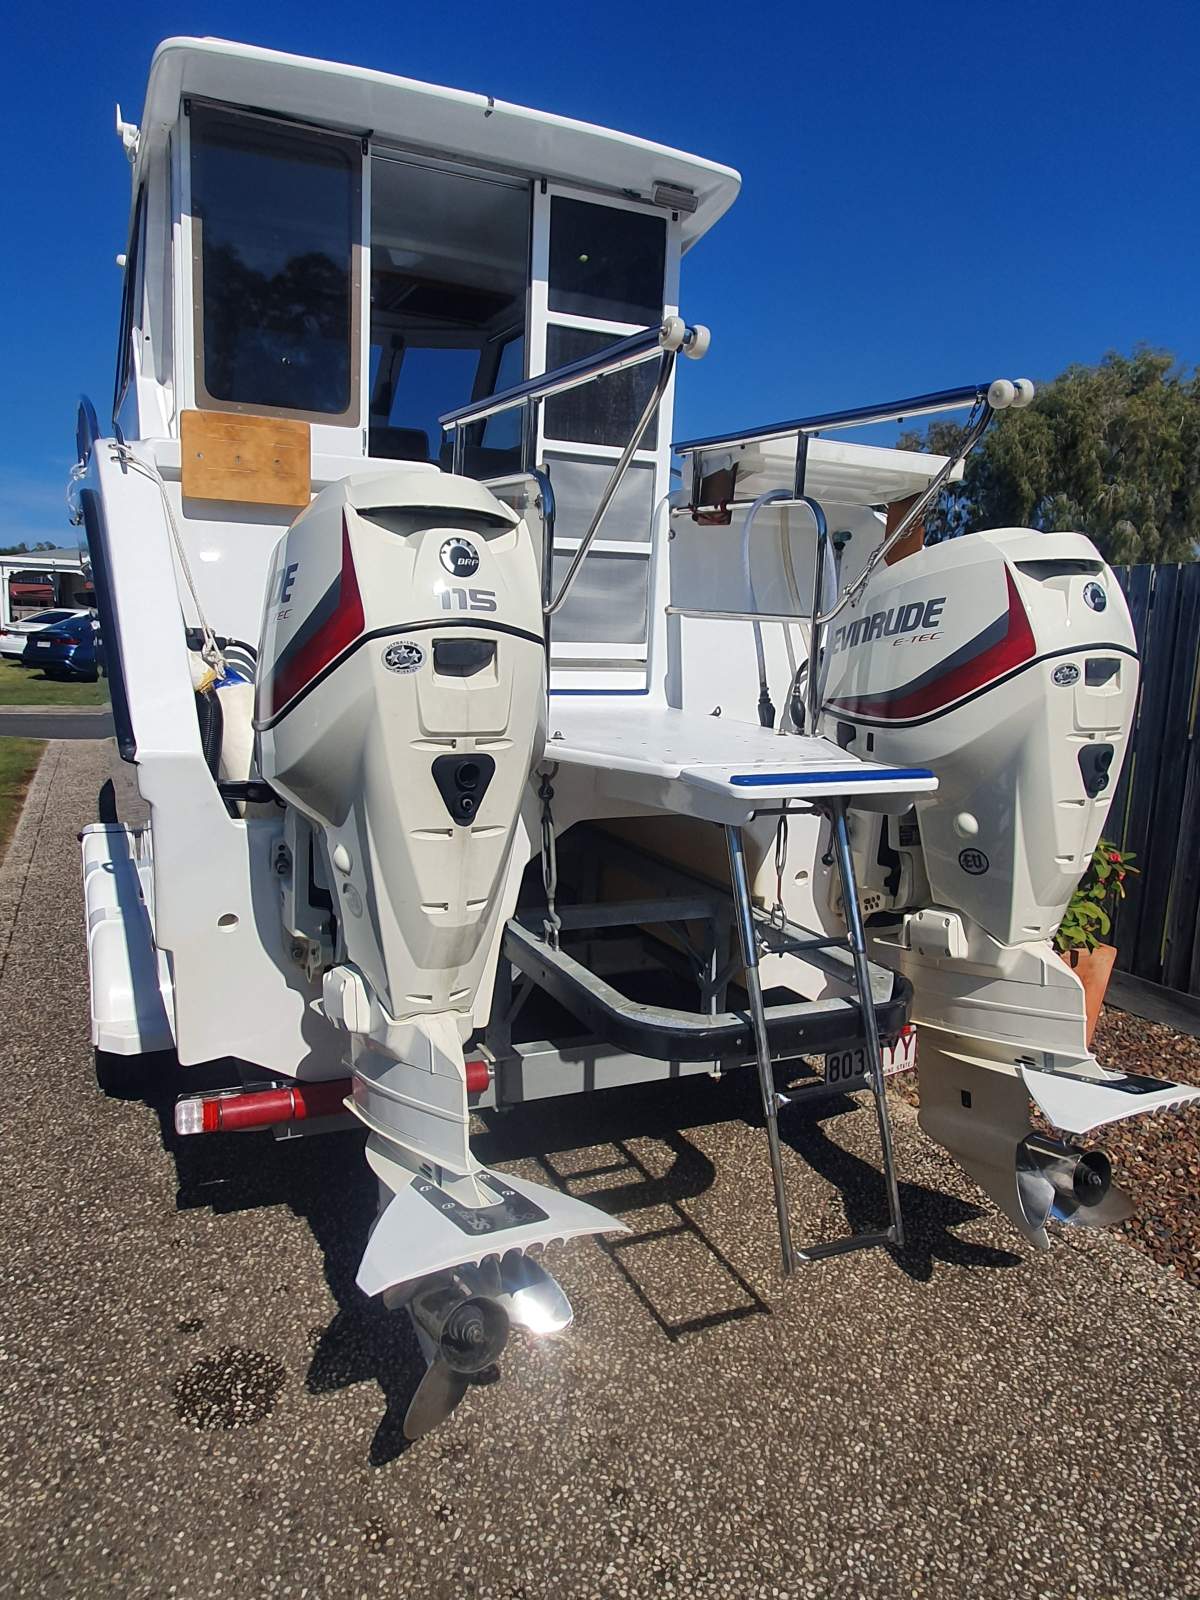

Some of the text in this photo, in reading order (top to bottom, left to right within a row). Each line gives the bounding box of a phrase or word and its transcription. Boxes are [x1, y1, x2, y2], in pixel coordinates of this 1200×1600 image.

[457, 557, 479, 566] BRP
[831, 597, 947, 655] EVINRUDE
[893, 632, 945, 647] E-TEC
[829, 1048, 865, 1083] 803
